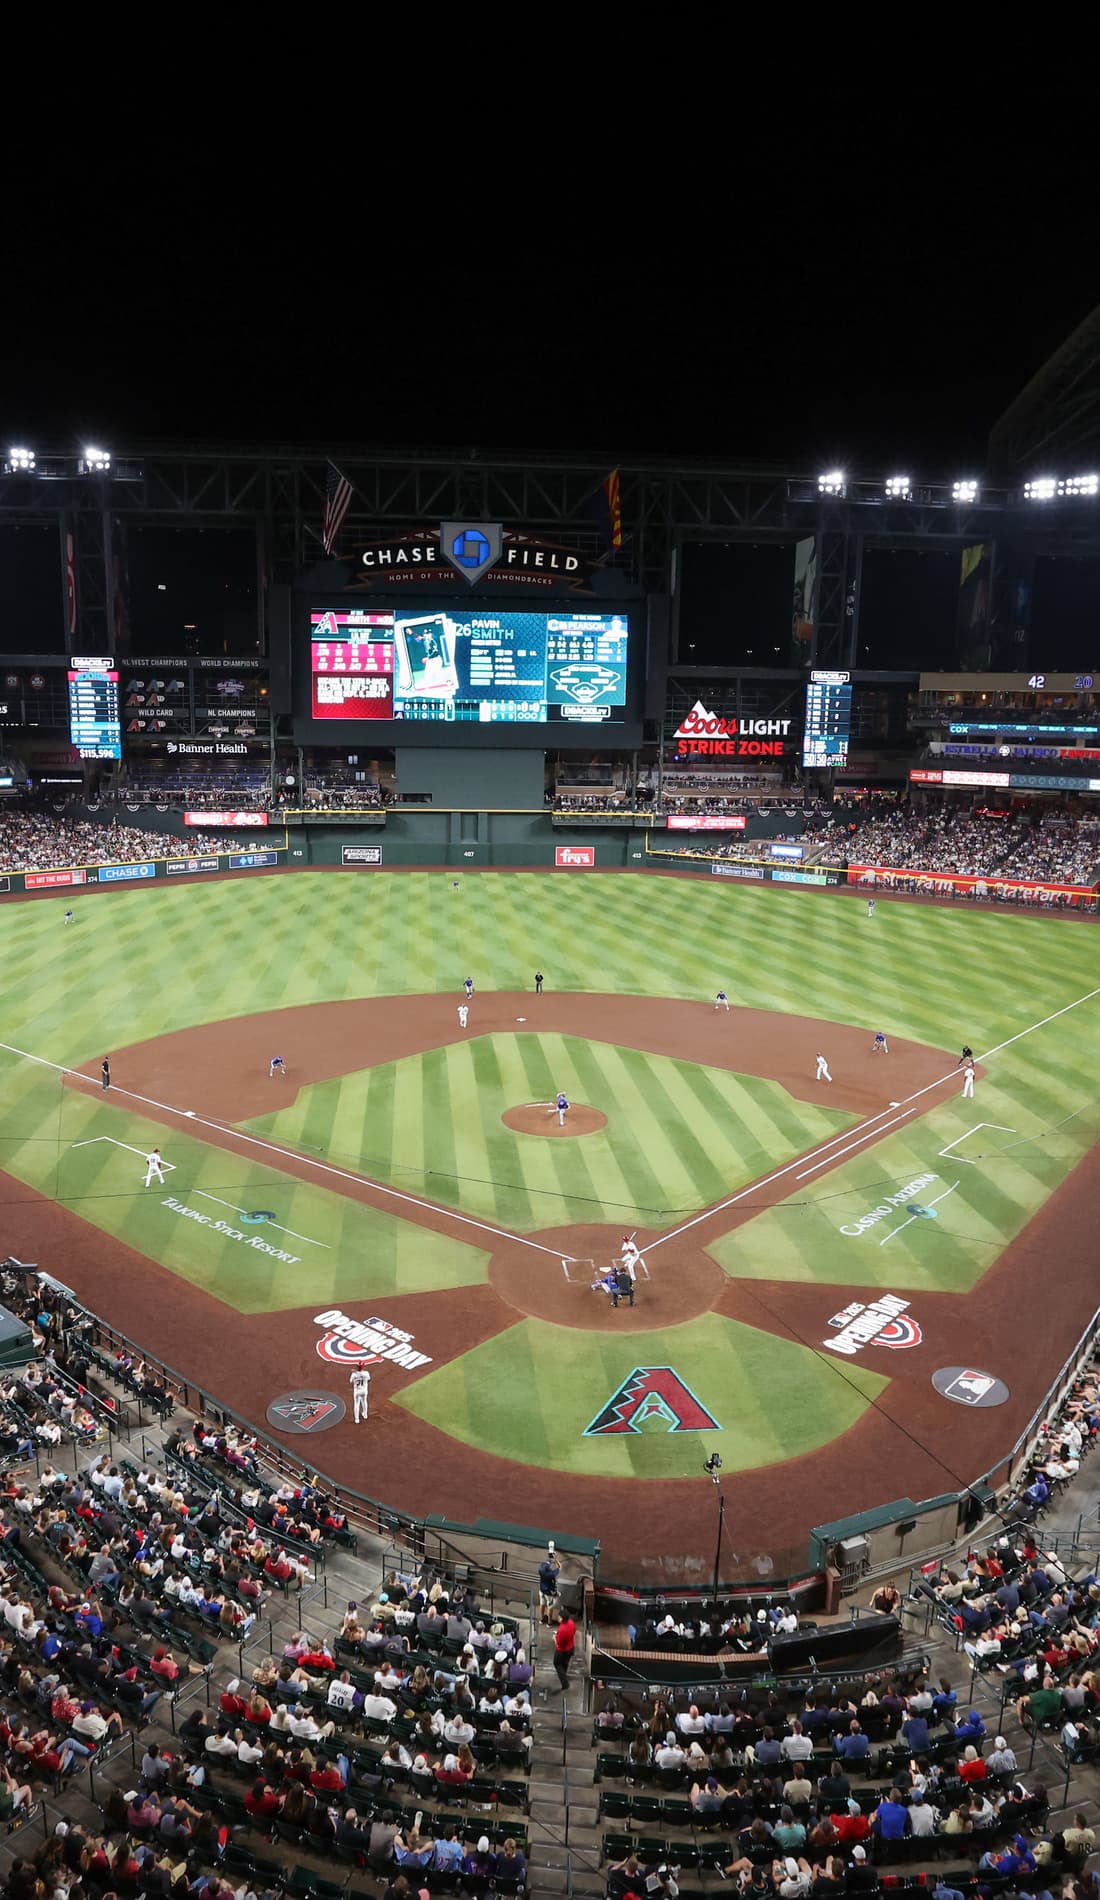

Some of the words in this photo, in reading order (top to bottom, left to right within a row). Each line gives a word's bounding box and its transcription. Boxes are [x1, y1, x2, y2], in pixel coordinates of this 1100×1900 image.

[362, 547, 436, 566] CHASE
[508, 549, 578, 571] FIELD
[389, 573, 414, 581] HOME
[487, 573, 552, 585] DIAMONDBACKS
[455, 623, 471, 636] 26
[472, 619, 500, 629] PAVIN
[472, 628, 514, 640] SMITH
[131, 659, 149, 667] WEST
[150, 659, 188, 667] CHAMPIONS
[223, 660, 259, 668] CHAMPIONS
[1028, 675, 1046, 688] 42
[1073, 676, 1094, 689] 20
[207, 709, 216, 717] NL
[217, 709, 256, 717] CHAMPIONS
[679, 710, 739, 734] Coors
[739, 720, 791, 736] LIGHT
[950, 725, 969, 734] COX
[80, 748, 114, 759] $115,596
[178, 743, 214, 753] Banner
[215, 743, 248, 754] Health
[677, 739, 736, 755] STRIKE
[738, 741, 784, 756] ZONE
[944, 744, 997, 755] ESTRELLA
[105, 868, 139, 878] CHASE
[779, 873, 798, 881] COX
[839, 1205, 893, 1237] CASINO
[883, 1172, 939, 1206] ARIZONA
[160, 1196, 211, 1225] TALKING
[208, 1220, 247, 1242] STICK
[246, 1235, 302, 1265] RESORT
[822, 1310, 895, 1355] OPENING
[867, 1293, 912, 1318] DAY
[313, 1309, 397, 1354] OPENING
[380, 1342, 433, 1370] DAY
[331, 1694, 345, 1706] 20
